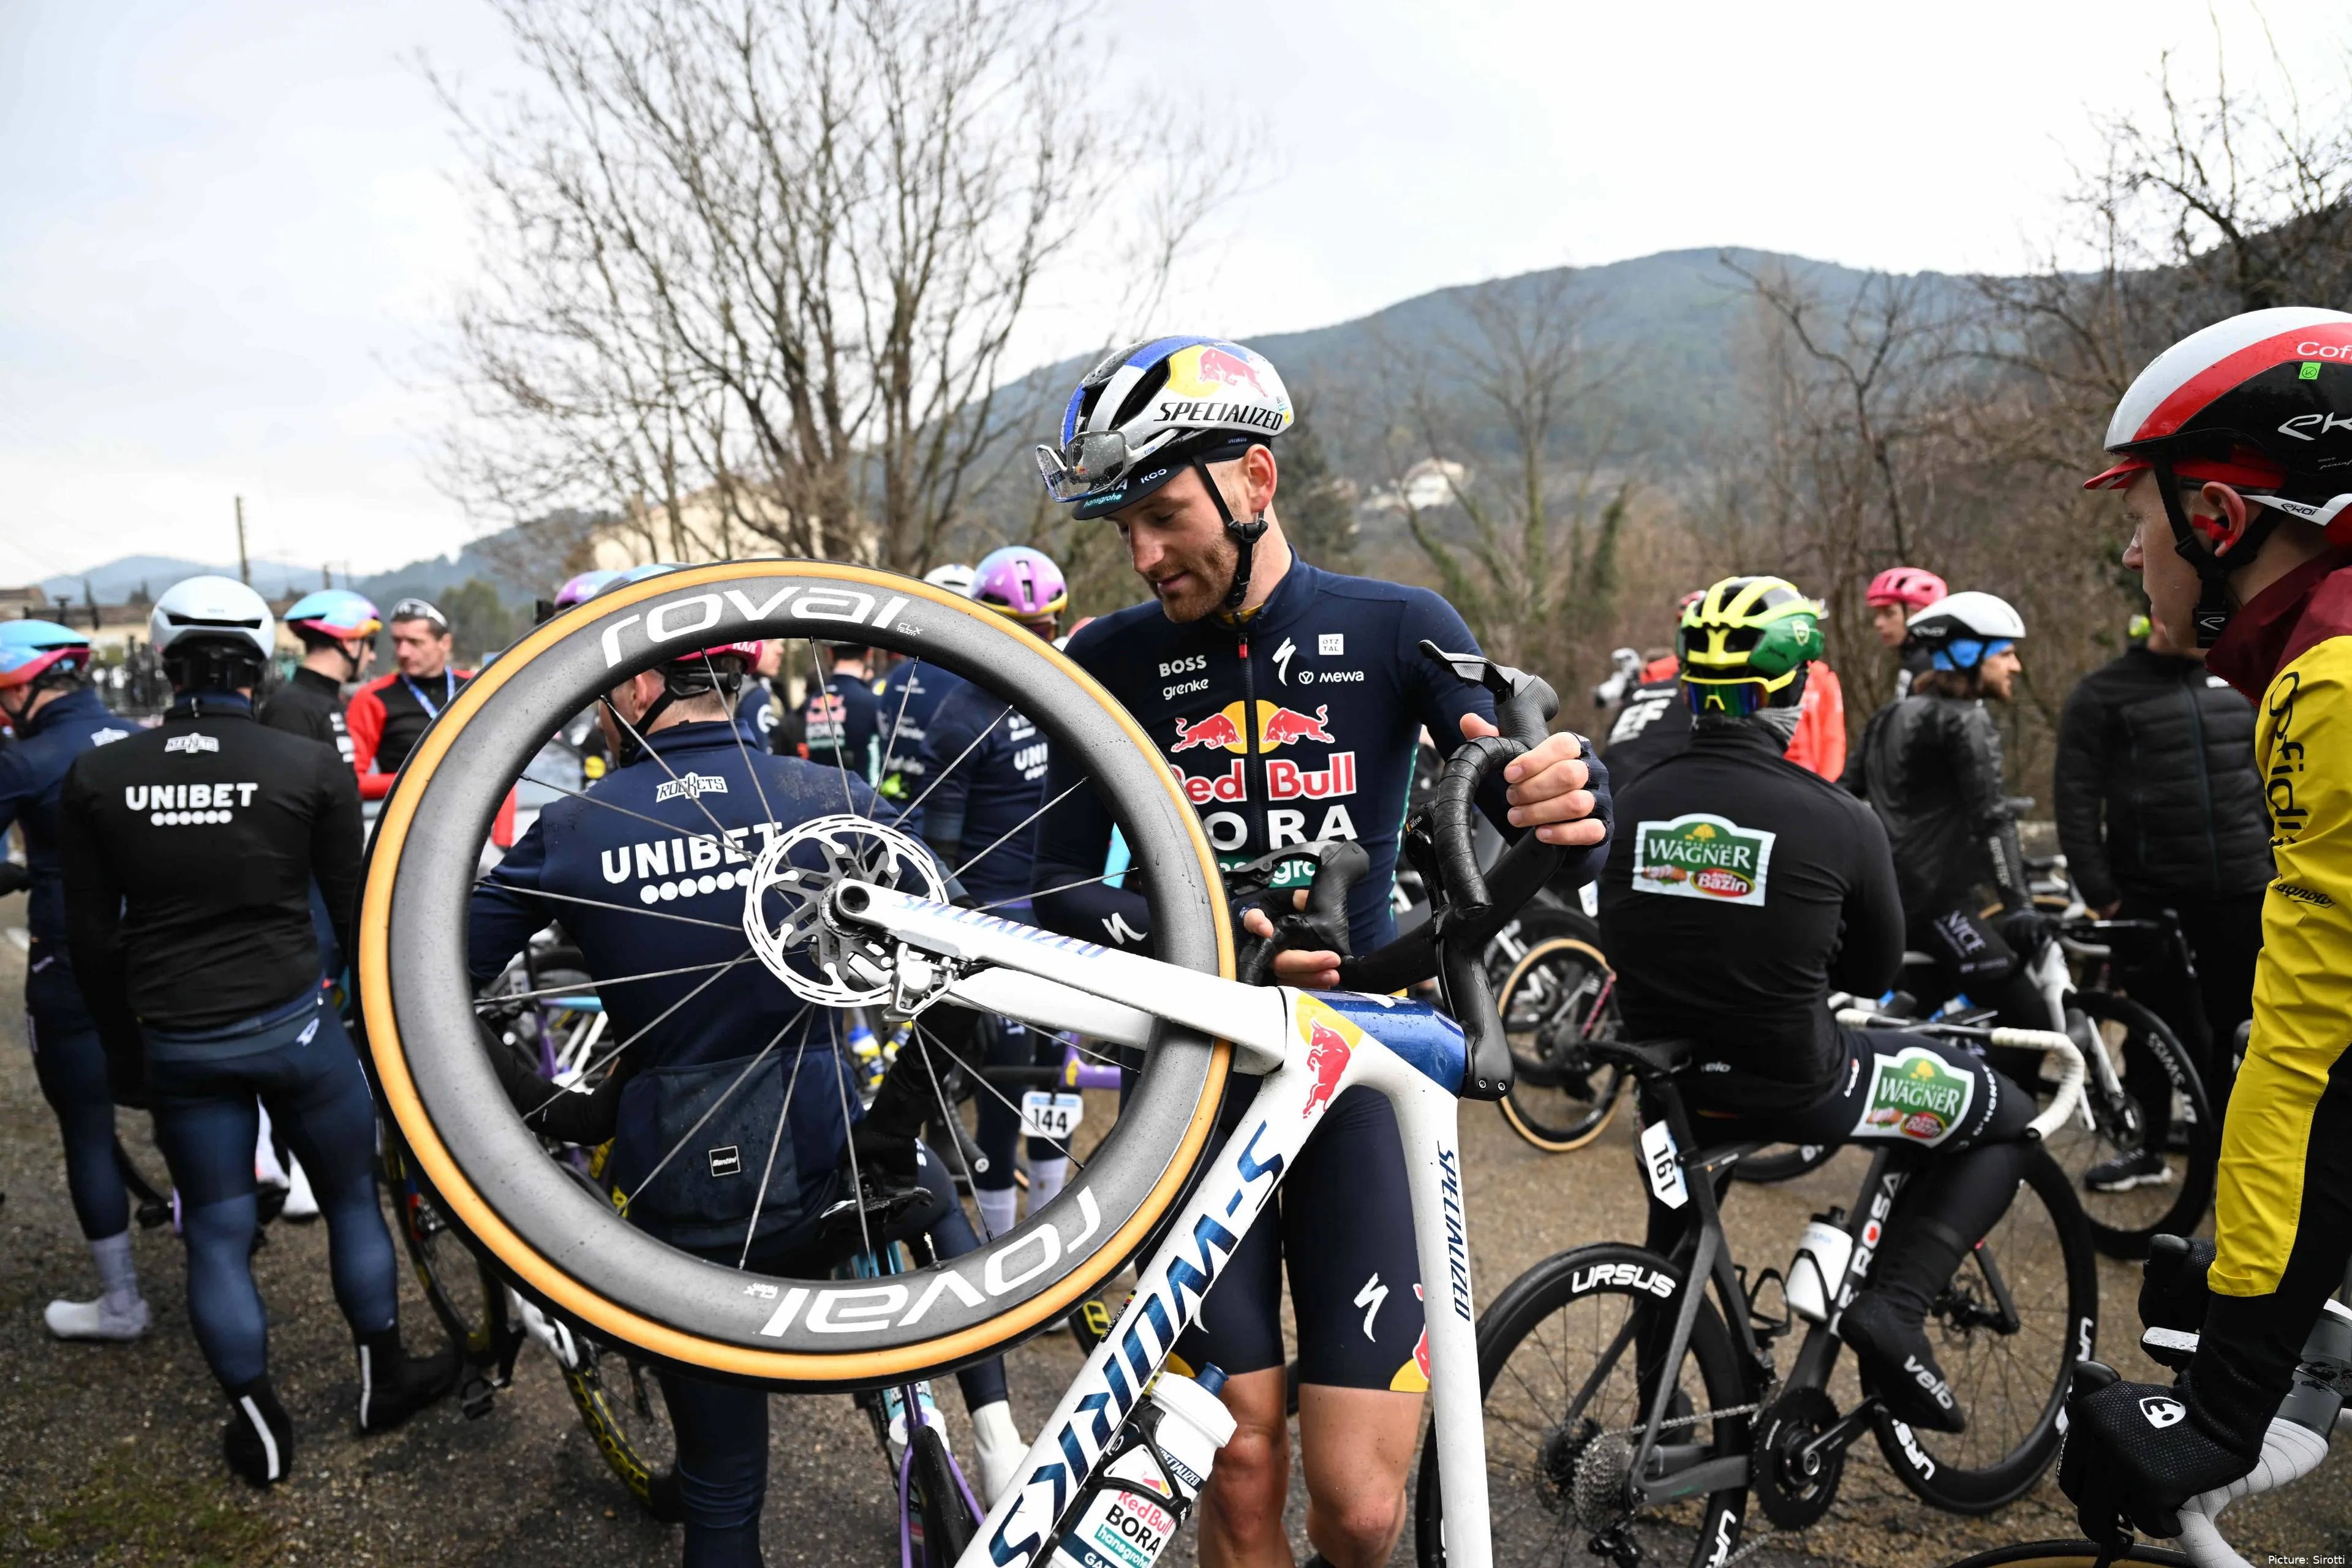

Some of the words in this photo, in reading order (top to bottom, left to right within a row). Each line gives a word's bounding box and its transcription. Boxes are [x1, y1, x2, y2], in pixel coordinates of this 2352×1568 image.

[2297, 342, 2352, 358] Cof
[1153, 402, 1283, 431] SPECIALIZED
[1084, 492, 1122, 508] hansgrohe
[601, 586, 910, 668] roval
[896, 627, 916, 636] TEAM
[897, 622, 923, 634] CLX
[1159, 655, 1207, 677] BOSS
[1163, 678, 1209, 700] grenke
[660, 775, 725, 799] ROCKETS
[1170, 758, 1247, 804] ed
[1265, 751, 1357, 801] Bull
[126, 782, 258, 811] UNIBET
[601, 821, 782, 883] UNIBET
[1649, 839, 1752, 870] WAGNER
[1697, 872, 1748, 893] Bazin
[892, 893, 1110, 959] SPECIALIZED
[1879, 1076, 1960, 1117] WAGNER
[1034, 1109, 1067, 1132] 144
[1652, 1144, 1677, 1193] 161
[1437, 1140, 1471, 1321] SPECIALIZED
[761, 1186, 1101, 1336] roval
[1572, 1264, 1676, 1299] URSUS
[1893, 1419, 1935, 1480] URS
[1158, 1448, 1201, 1487] PECIALIZED
[1106, 1504, 1161, 1556] BORA
